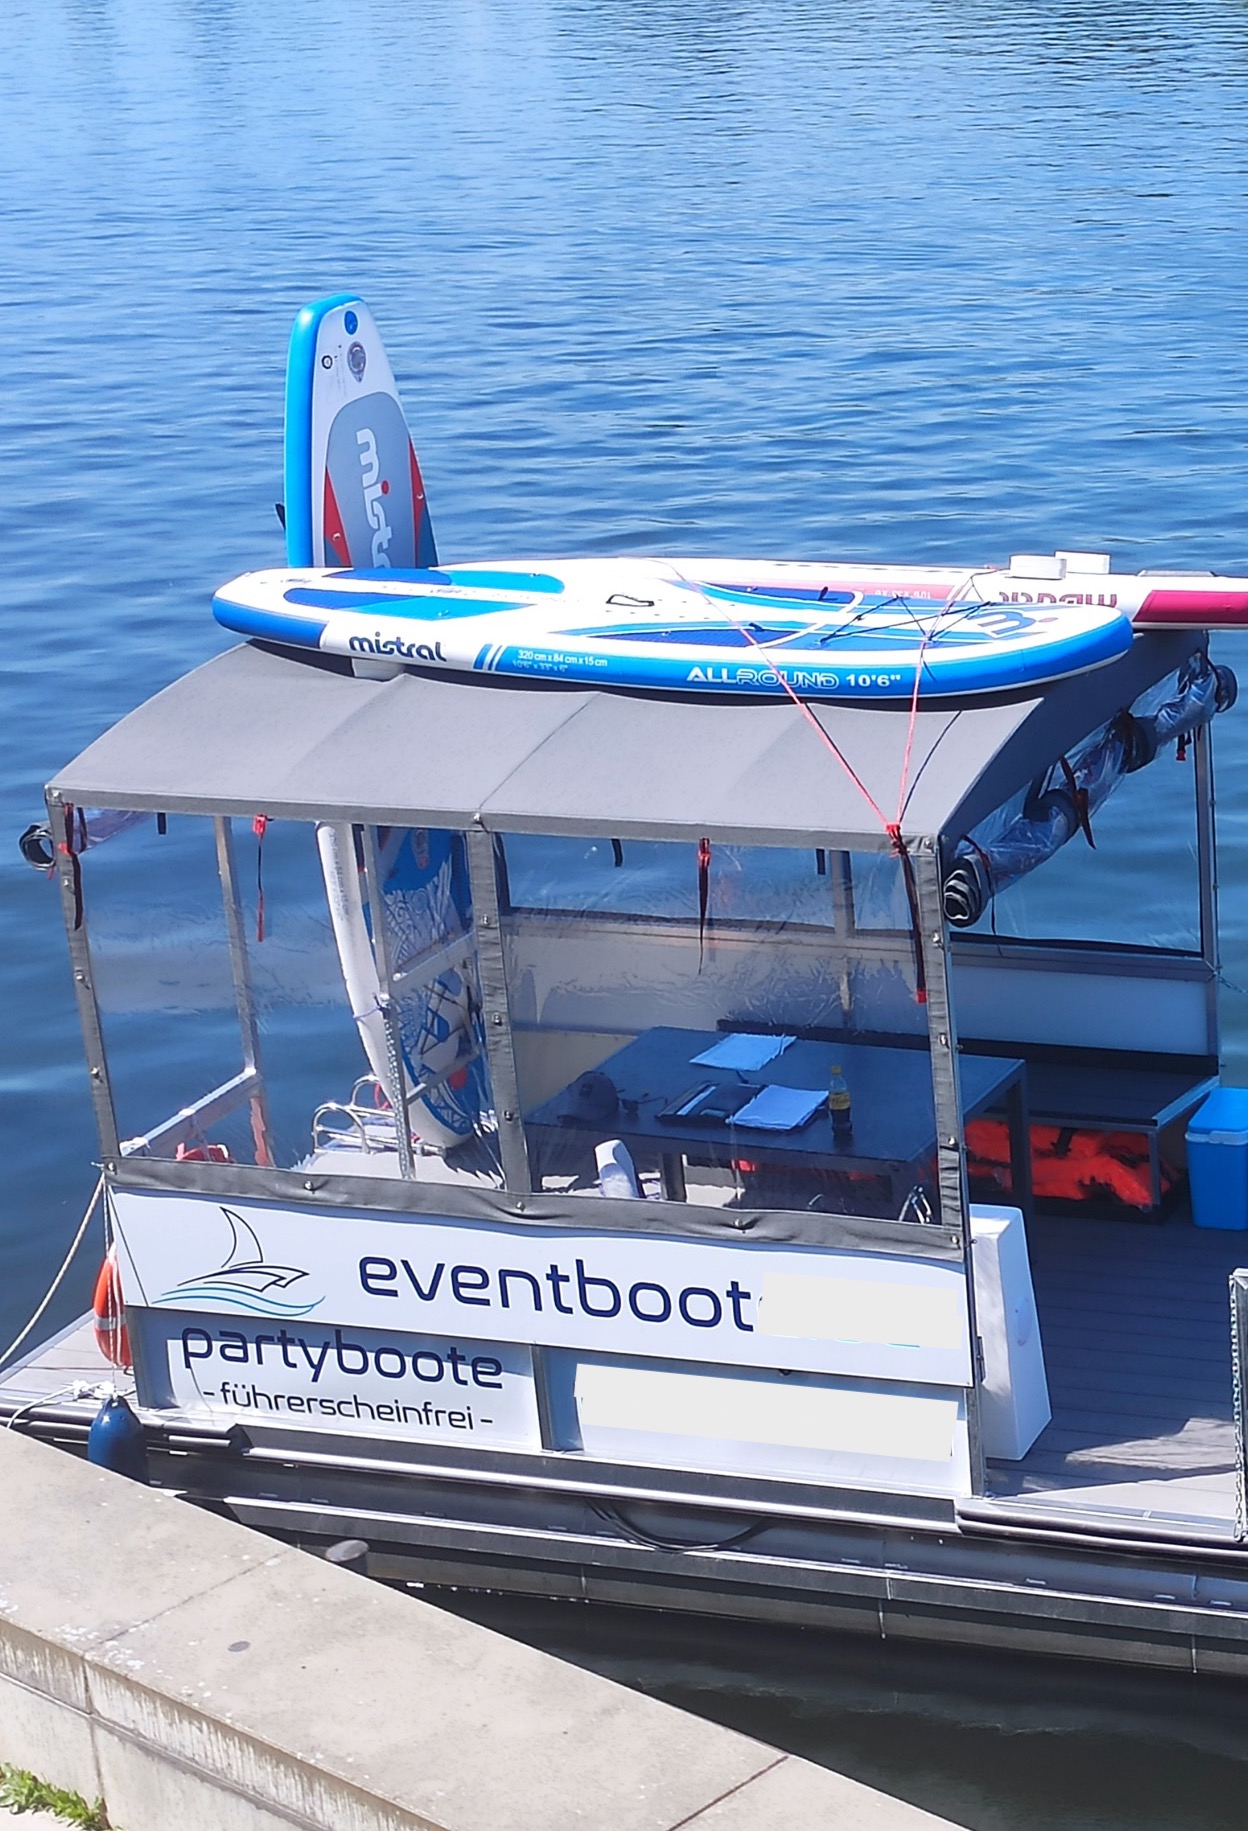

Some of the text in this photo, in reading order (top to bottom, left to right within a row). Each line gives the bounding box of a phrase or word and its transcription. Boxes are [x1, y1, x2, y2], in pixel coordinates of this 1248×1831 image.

[349, 631, 447, 662] mistral
[686, 666, 902, 690] ALLROUND 10'6"
[359, 1256, 763, 1332] eventboot
[181, 1327, 503, 1389] partyboote
